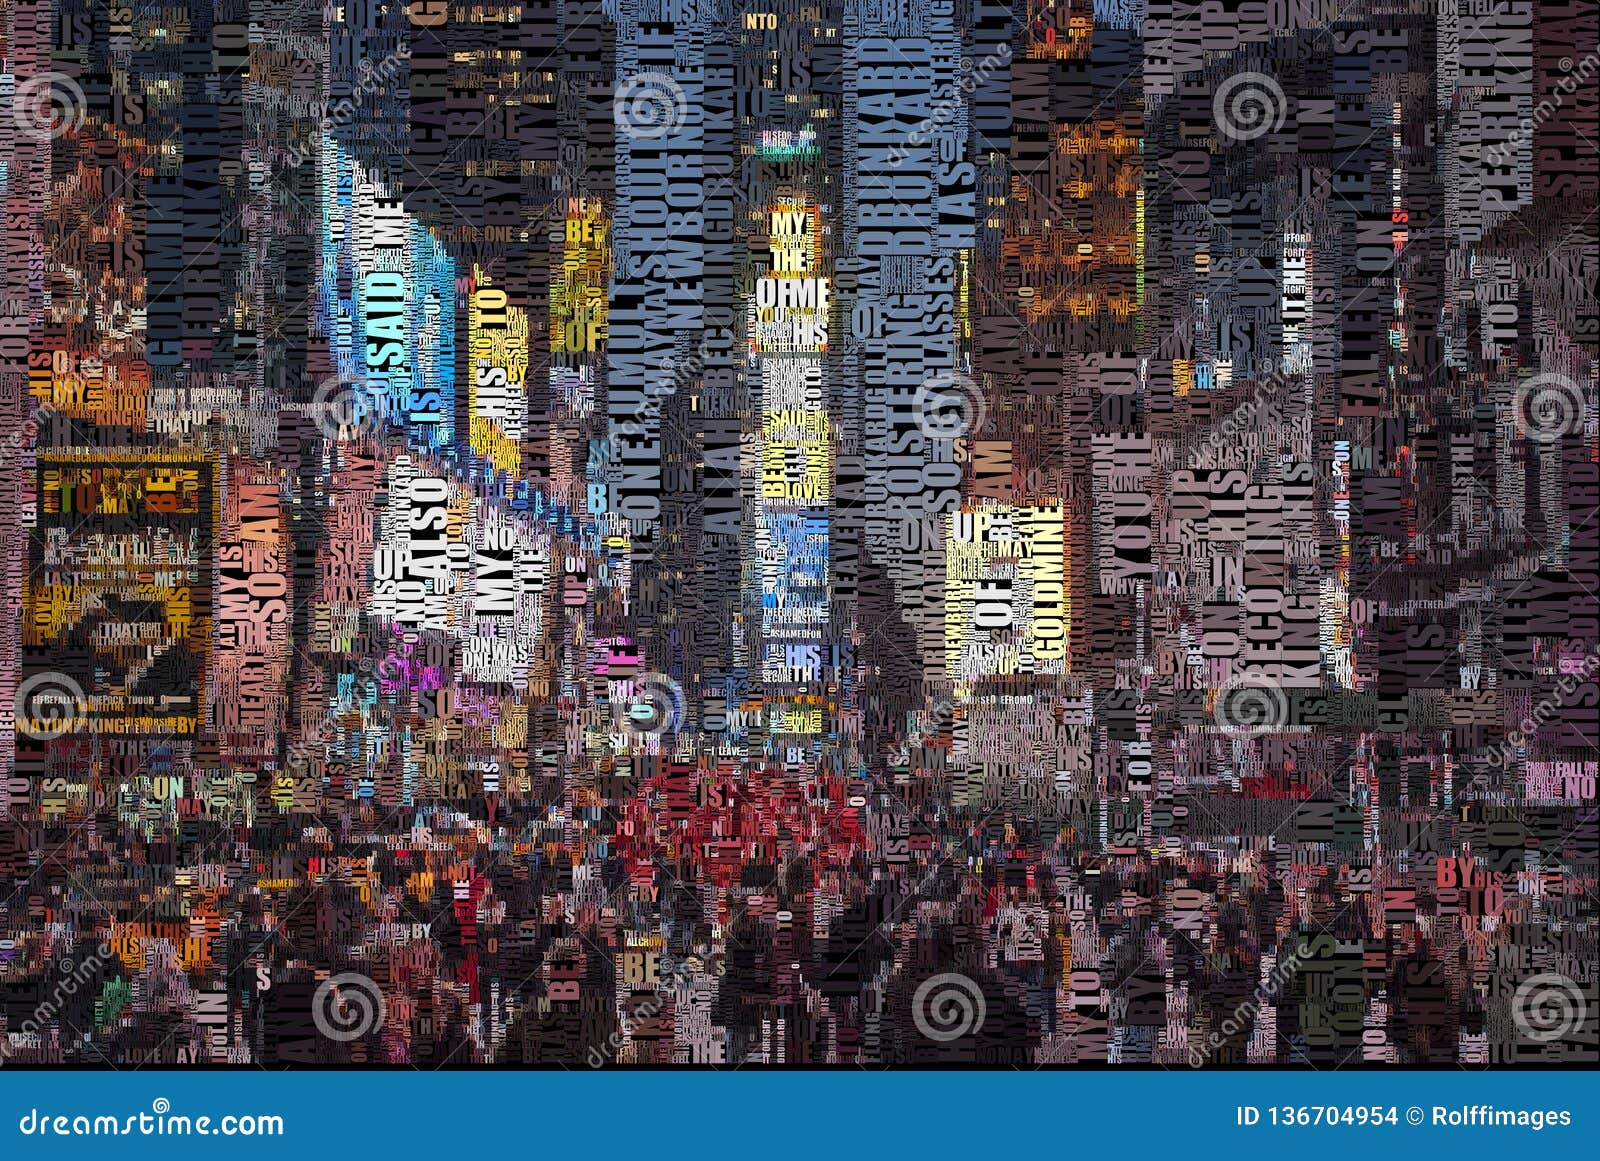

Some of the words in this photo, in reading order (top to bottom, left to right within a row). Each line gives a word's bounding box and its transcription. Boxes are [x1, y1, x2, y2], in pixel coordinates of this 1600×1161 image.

[110, 7, 132, 51] HIS
[741, 13, 777, 29] INTO
[1204, 0, 1240, 49] UP
[639, 24, 675, 59] IF
[1143, 0, 1174, 95] HEART
[1458, 15, 1497, 86] FOR
[1498, 0, 1533, 96] KING
[411, 0, 448, 158] CARING
[1297, 100, 1336, 150] ON
[161, 145, 176, 155] HIS
[858, 37, 893, 256] DRUNKARD
[893, 37, 931, 256] DRUNKARD
[1481, 96, 1517, 212] PEARL
[249, 162, 264, 190] FOR
[936, 162, 975, 248] HAS
[359, 184, 374, 272] DRUNKARD
[374, 202, 403, 245] ME
[566, 220, 594, 241] BE
[772, 213, 804, 234] MY
[1392, 212, 1409, 242] HIS
[1077, 244, 1094, 260] TO
[1357, 221, 1395, 271] ON
[771, 251, 806, 271] THE
[1284, 257, 1306, 285] HE
[424, 294, 441, 315] UP
[756, 279, 788, 307] OF
[788, 279, 829, 307] ME
[1284, 286, 1306, 294] FIGHT
[367, 273, 403, 366] SAID
[476, 290, 507, 325] TO
[1284, 295, 1306, 319] IT
[1489, 302, 1518, 339] TO
[336, 315, 352, 350] IDOL
[792, 323, 828, 344] HIS
[922, 257, 955, 387] GLASSES
[1284, 323, 1298, 342] HE
[2, 316, 30, 372] FOR
[475, 337, 492, 359] NO
[505, 338, 521, 359] SO
[565, 323, 600, 351] OF
[29, 354, 52, 396] HIS
[87, 357, 103, 410] BROKE
[366, 368, 388, 395] OF
[508, 367, 527, 381] BY
[580, 367, 593, 381] HIS
[865, 338, 887, 403] GOLD
[1217, 360, 1232, 381] ME
[53, 382, 88, 403] MY
[477, 368, 506, 417] HIS
[806, 368, 822, 410] GOLD
[191, 411, 212, 425] UP
[410, 390, 440, 423] IS
[506, 382, 521, 440] DECREE
[770, 411, 805, 425] SAID
[886, 295, 924, 513] ROISTERING
[157, 420, 189, 433] THAT
[739, 432, 755, 469] WAS
[770, 440, 785, 470] ONE
[1091, 433, 1115, 476] ONE
[620, 440, 662, 519] ONE
[784, 449, 799, 483] TELL
[864, 403, 887, 534] DRUNKARD
[146, 469, 175, 513] BE
[763, 470, 784, 498] BE
[786, 484, 821, 497] LOVE
[922, 463, 961, 511] SO
[1172, 468, 1210, 520] UP
[1281, 462, 1314, 515] HIS
[22, 482, 37, 527] LEAVE
[238, 485, 279, 542] AM
[1211, 469, 1247, 540] HIS
[1333, 491, 1349, 520] ONE
[410, 479, 448, 578] ALSO
[447, 506, 462, 543] LOVE
[485, 528, 512, 549] NO
[953, 514, 987, 541] UP
[989, 513, 1012, 542] BE
[1021, 506, 1035, 542] FALL
[1114, 490, 1151, 577] YOU
[119, 543, 150, 557] TELL
[220, 546, 242, 569] IS
[374, 548, 411, 580] UP
[447, 543, 469, 571] TO
[998, 542, 1032, 557] MAY
[519, 550, 543, 592] THE
[565, 558, 586, 572] ON
[1212, 558, 1243, 585] IN
[249, 572, 286, 622] SO
[374, 581, 396, 614] HIS
[476, 555, 513, 614] MY
[565, 575, 587, 606] UP
[1033, 507, 1064, 659] GOLDMINE
[1245, 486, 1284, 688] BECOMING
[218, 580, 250, 621] MY
[397, 581, 424, 621] NO
[425, 596, 448, 631] AM
[762, 594, 784, 608] MY
[975, 582, 1012, 626] OF
[1351, 600, 1378, 623] OF
[944, 579, 961, 660] NEWBORN
[1202, 606, 1237, 656] ON
[470, 637, 495, 651] ONE
[493, 647, 528, 661] WAS
[968, 644, 1003, 661] ALSO
[1187, 647, 1202, 665] BE
[1282, 595, 1320, 688] KING
[463, 652, 492, 666] ONE
[999, 660, 1018, 674] UP
[1018, 653, 1034, 674] TO
[514, 661, 528, 689] ONE
[617, 681, 648, 695] HIS
[1460, 676, 1481, 689] BY
[2, 661, 14, 740] BECOMING
[418, 690, 450, 717] SO
[1064, 698, 1084, 725] BE
[1136, 704, 1151, 733] HIS
[609, 734, 628, 747] SO
[952, 718, 968, 755] WAY
[1041, 725, 1081, 742] MAY
[719, 747, 741, 755] LEAVE
[787, 748, 805, 762] BE
[1128, 740, 1151, 791] FOR
[483, 762, 499, 792] HIS
[983, 762, 1019, 777] INTO
[1555, 762, 1584, 776] FALL
[42, 777, 67, 813] HIS
[154, 777, 184, 800] ON
[213, 777, 228, 806] ONE
[277, 777, 293, 806] HIS
[1241, 836, 1275, 851] TIME
[175, 866, 191, 885] HE
[1349, 867, 1372, 891] IS
[1437, 857, 1475, 888] BY
[1518, 879, 1547, 894] ONE
[640, 887, 658, 902] BY
[1065, 894, 1092, 910] THE
[777, 911, 792, 929] TO
[1173, 890, 1201, 929] NO
[190, 917, 205, 938] ME
[412, 924, 431, 939] BY
[185, 938, 213, 961] HE
[624, 953, 659, 982] BE
[1071, 971, 1100, 1005] TO
[196, 991, 228, 1024] IN
[212, 1025, 227, 1056] IDOL
[690, 1042, 725, 1061] THE
[1167, 1029, 1187, 1047] ON
[1364, 1030, 1386, 1062] NO
